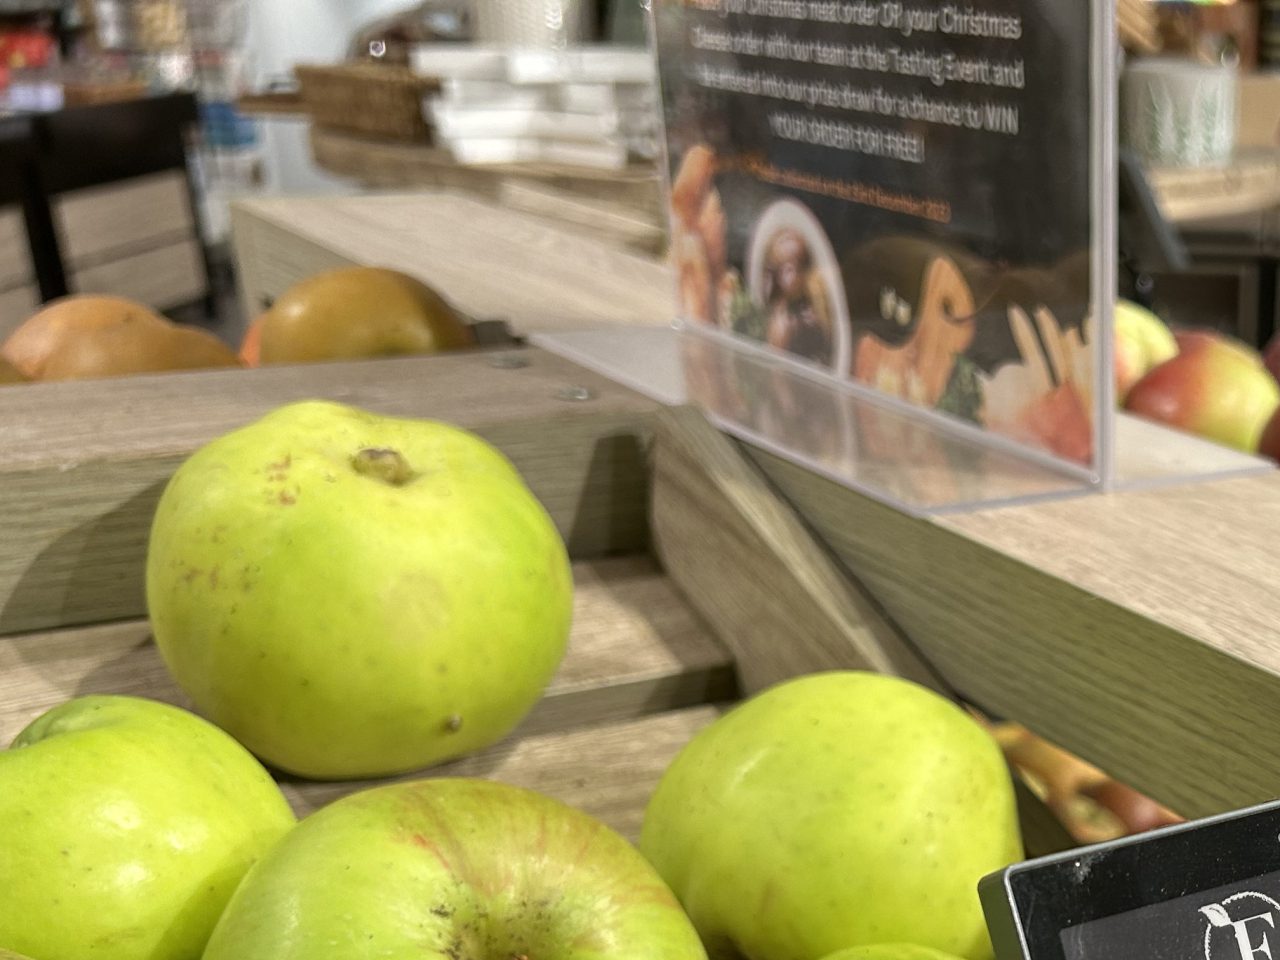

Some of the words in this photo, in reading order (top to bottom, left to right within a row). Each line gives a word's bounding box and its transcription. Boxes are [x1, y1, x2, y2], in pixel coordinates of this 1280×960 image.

[900, 8, 939, 37] your
[938, 5, 1022, 40] Christmas
[944, 53, 992, 85] Event
[991, 58, 1025, 89] and
[962, 102, 984, 129] to
[983, 100, 1019, 135] WIN
